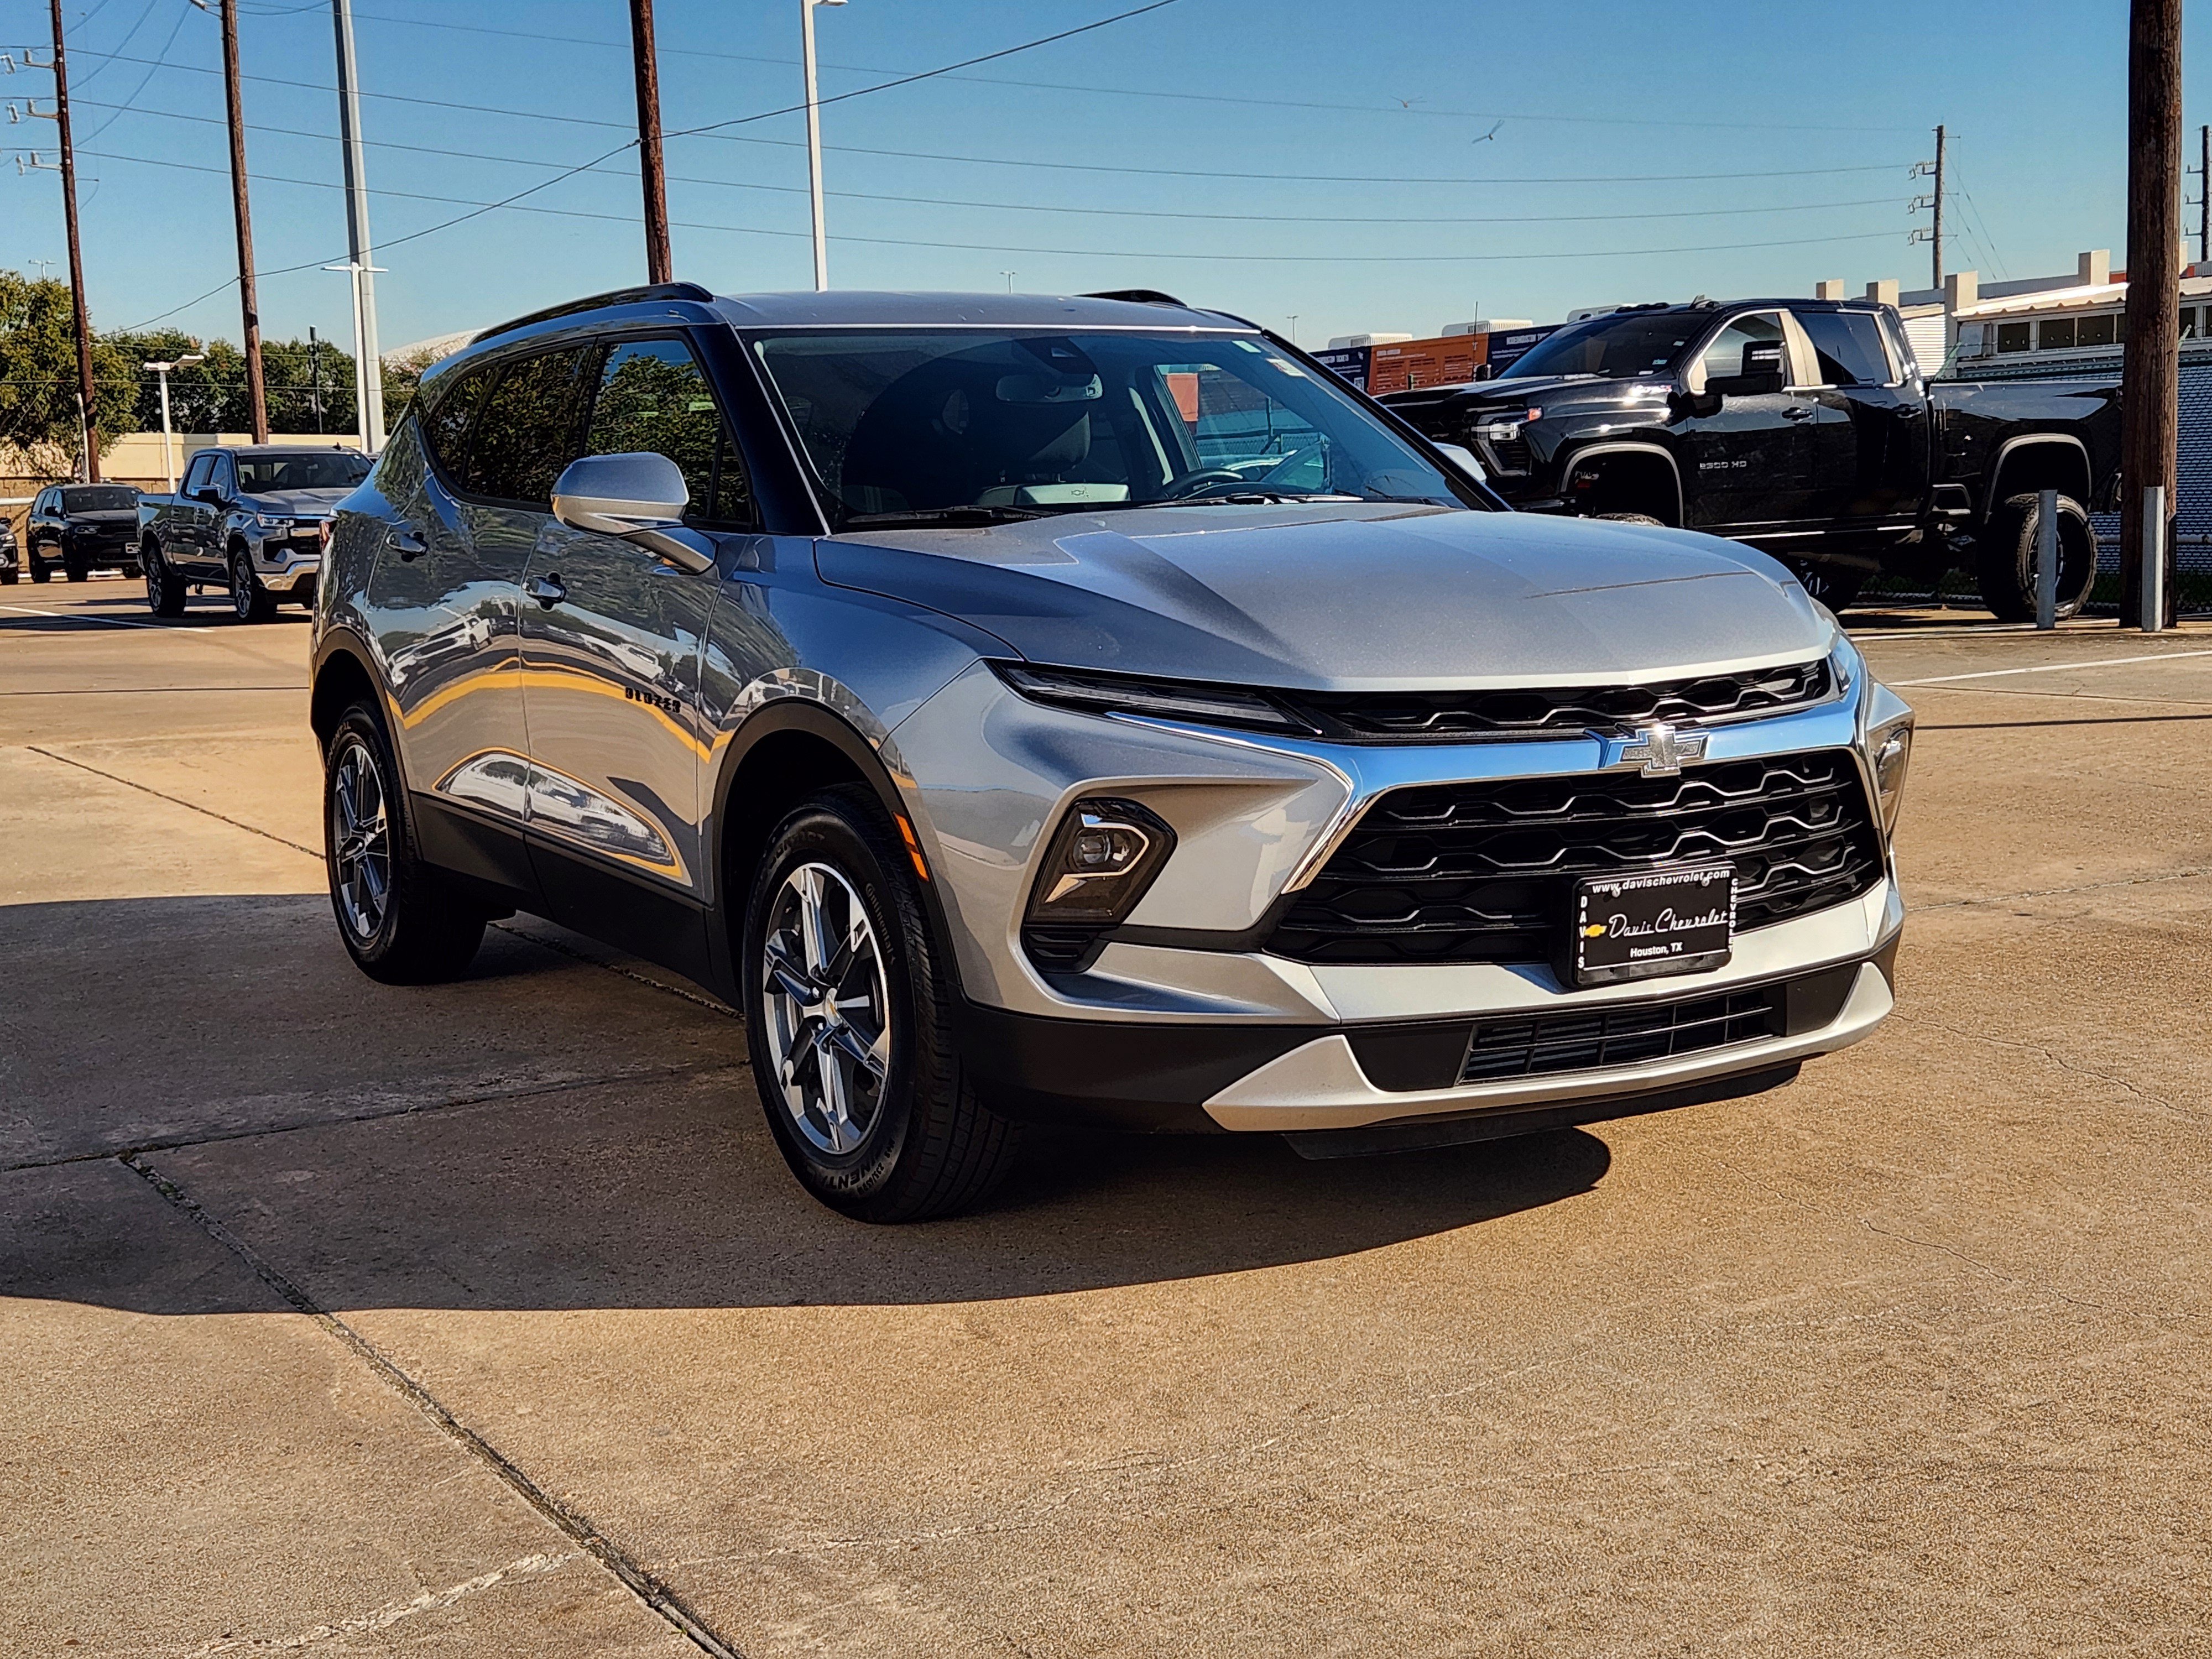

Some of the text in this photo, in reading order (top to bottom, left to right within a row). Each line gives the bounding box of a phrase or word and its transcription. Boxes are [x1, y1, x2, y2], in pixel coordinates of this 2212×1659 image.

[1699, 461, 1729, 469] 2500
[625, 687, 681, 713] BLAZER
[1592, 870, 1730, 894] www.davischevrolet.com
[866, 883, 894, 953] Continental
[1609, 907, 1729, 938] Davis Chevrolet
[1578, 896, 1588, 968] DAVIS
[1630, 942, 1683, 958] Houston, TX
